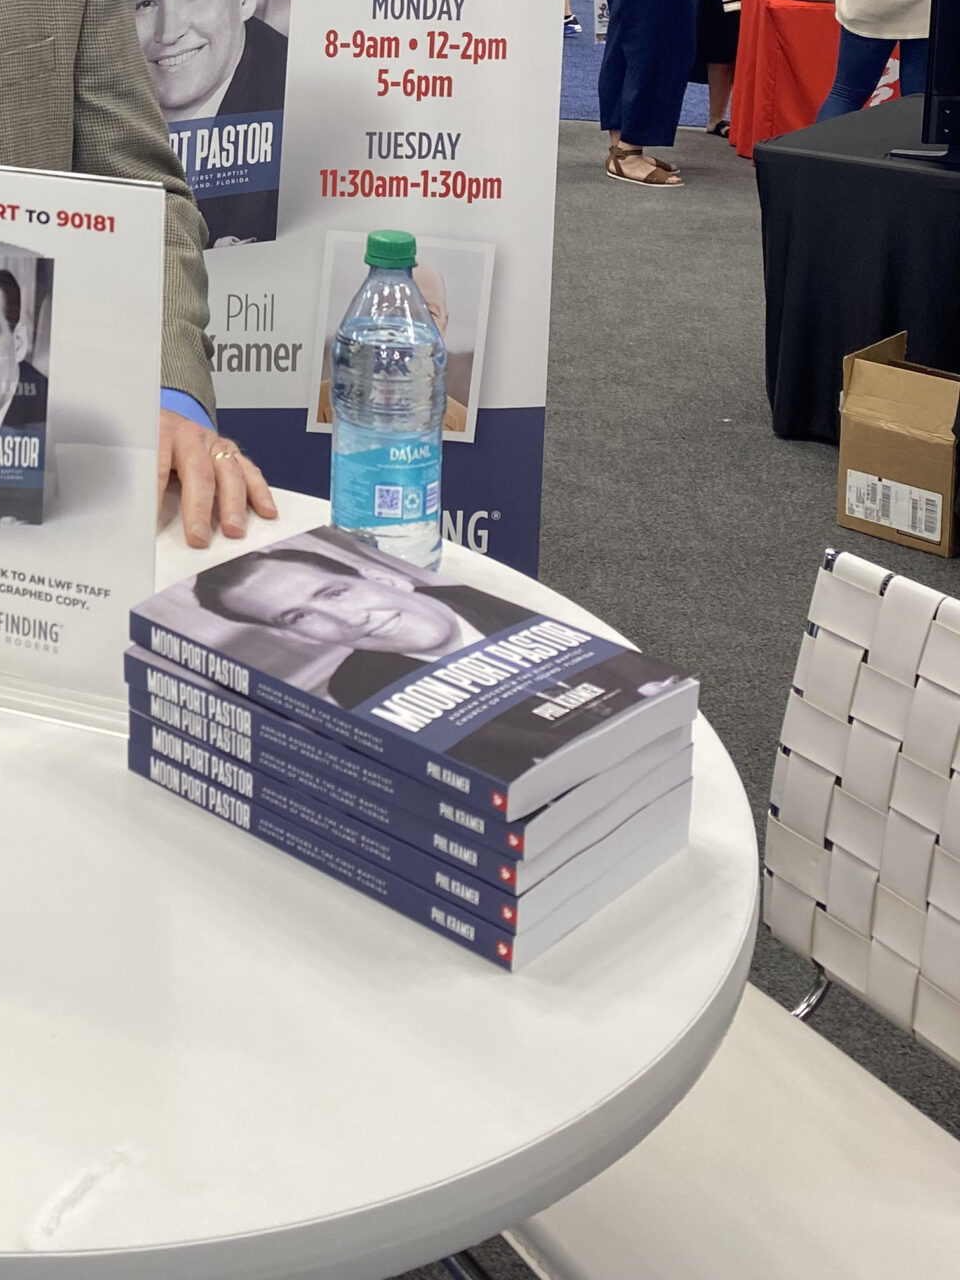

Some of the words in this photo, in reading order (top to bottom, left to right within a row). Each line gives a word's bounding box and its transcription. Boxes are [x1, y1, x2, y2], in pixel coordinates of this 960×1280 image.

[325, 30, 399, 58] 8-9am
[427, 31, 507, 64] 12-2pm
[377, 69, 452, 101] 5-6pm
[195, 122, 273, 171] PASTOR
[366, 132, 461, 159] TUESDAY
[192, 174, 213, 182] FIRST
[217, 170, 248, 178] BAPTIST
[217, 177, 249, 186] FLORIDA
[320, 170, 502, 203] 11:30am-1:30pm
[26, 209, 50, 224] TO
[56, 211, 115, 232] 90181
[227, 294, 274, 331] Phil
[210, 335, 302, 372] ramer
[390, 445, 431, 463] DASANI
[11, 571, 26, 582] TO
[29, 575, 45, 586] AN
[49, 579, 73, 591] LWF
[75, 584, 111, 599] STAFF
[56, 595, 90, 610] COPY.
[5, 636, 59, 654] ROGERS
[151, 626, 180, 662] MOON
[181, 641, 207, 674] PORT
[208, 654, 249, 695] PASTOR
[370, 676, 471, 733] MOON
[433, 651, 519, 694] PORT
[484, 621, 592, 668] PASTOR
[147, 668, 178, 703] MOON
[180, 682, 206, 718] PORT
[208, 695, 251, 737] PASTOR
[181, 709, 208, 741] PORT
[209, 722, 252, 763] PASTOR
[152, 726, 181, 763] MOON
[184, 742, 209, 776] PORT
[211, 756, 253, 798] PASTOR
[427, 761, 441, 781] PHIL
[442, 768, 470, 794] KRAMER
[150, 756, 179, 793] MOON
[181, 773, 207, 806] PORT
[209, 786, 250, 830] PASTOR
[439, 802, 454, 821] PHIL
[455, 809, 485, 834] KRAMER
[433, 833, 448, 853] PHIL
[449, 841, 478, 867] KRAMER
[436, 872, 450, 891] PHIL
[451, 879, 480, 906] KRAMER
[431, 906, 445, 926] PHIL
[446, 915, 475, 942] KRAMER
